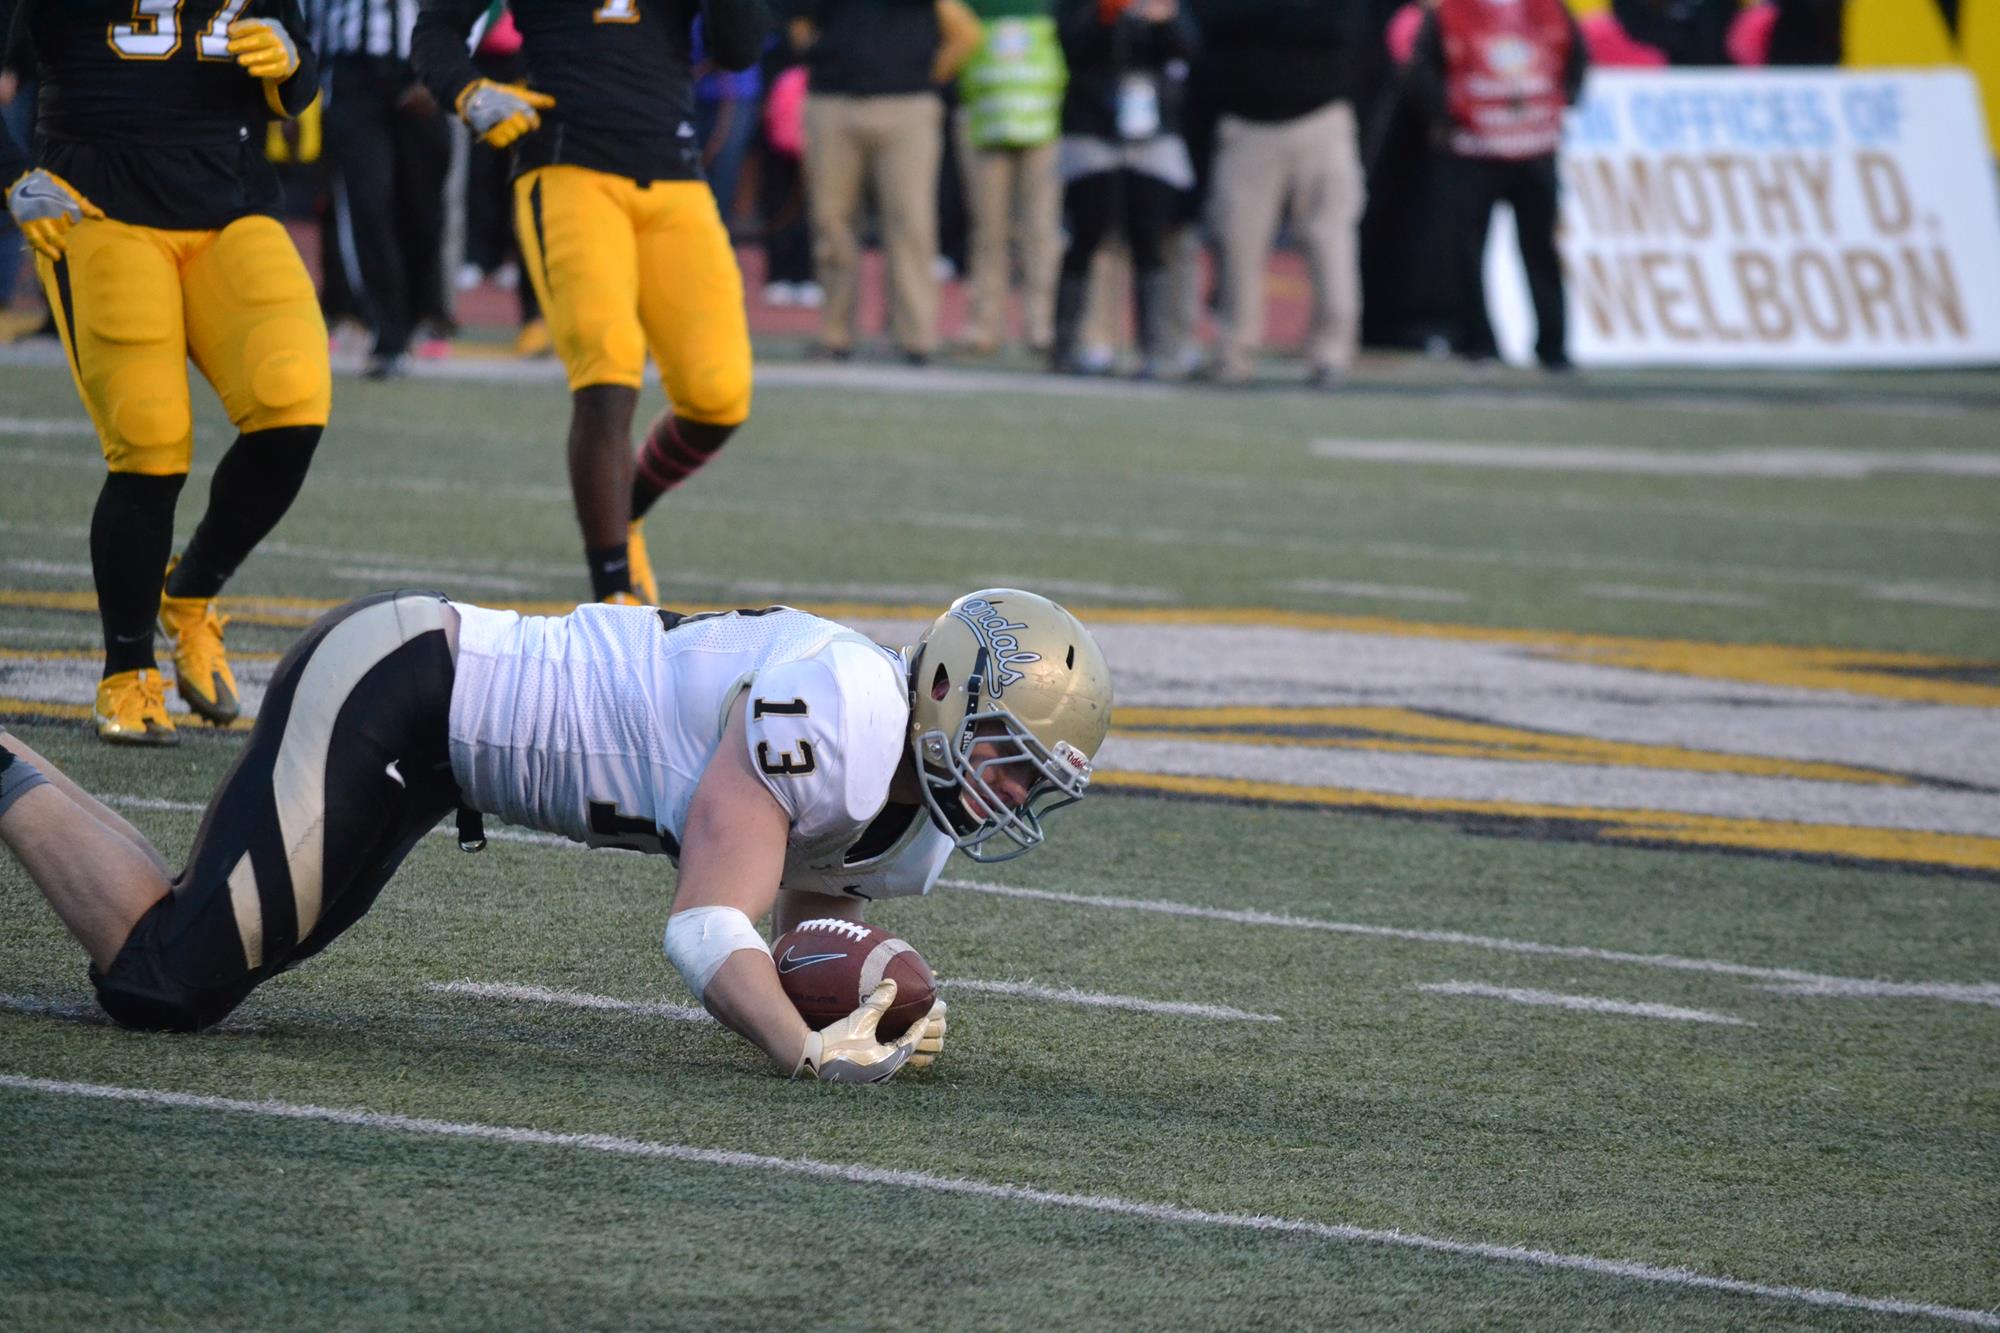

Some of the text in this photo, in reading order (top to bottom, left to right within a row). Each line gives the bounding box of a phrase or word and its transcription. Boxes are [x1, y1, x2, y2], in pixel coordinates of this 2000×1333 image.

[1630, 85, 1836, 148] OFFICES
[1842, 83, 1905, 147] OF
[1556, 152, 1836, 240] IMOTHY
[951, 599, 1042, 699] andals
[753, 696, 817, 776] 13
